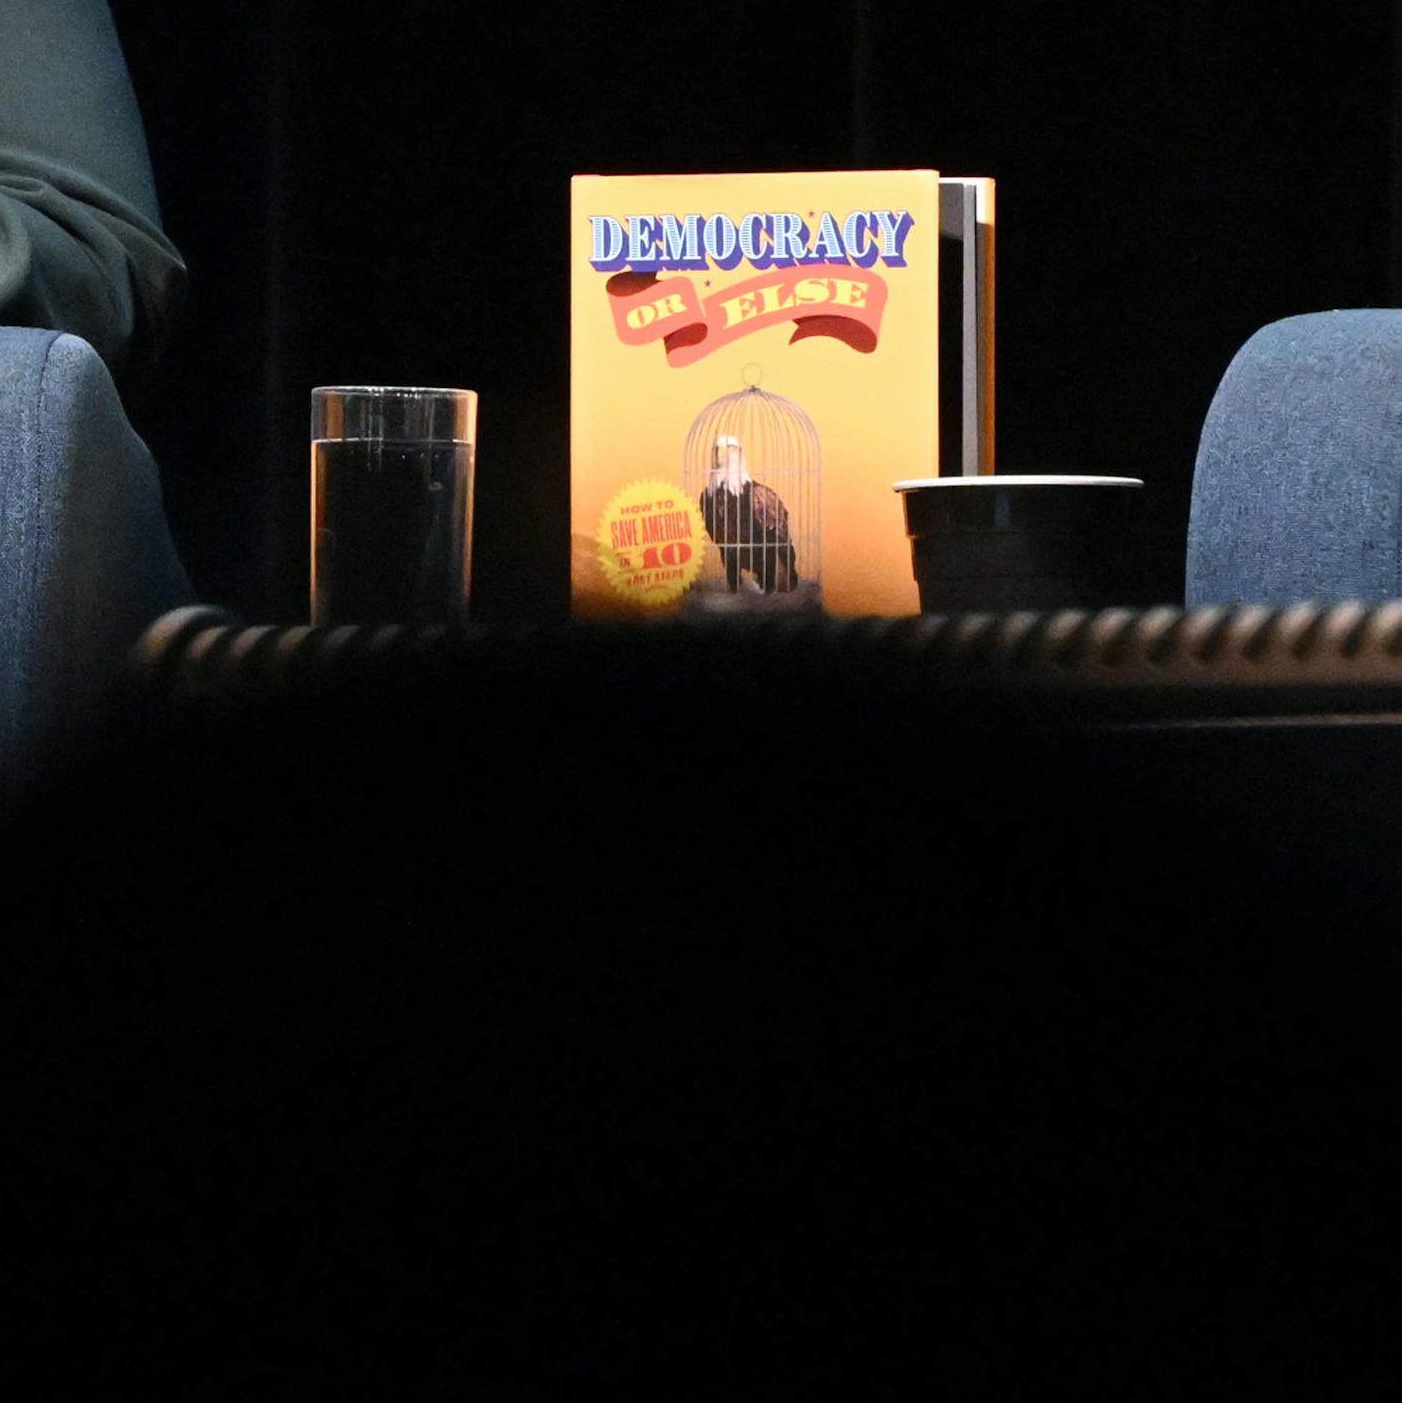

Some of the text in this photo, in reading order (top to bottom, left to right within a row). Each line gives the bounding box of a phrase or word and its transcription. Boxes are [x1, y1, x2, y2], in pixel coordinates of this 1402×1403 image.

[589, 210, 914, 271] DEMOCRACY
[626, 278, 869, 329] OR ELSE
[620, 500, 674, 515] HOW TO
[611, 510, 692, 549] SAVE AMERICA
[639, 542, 693, 569] 10
